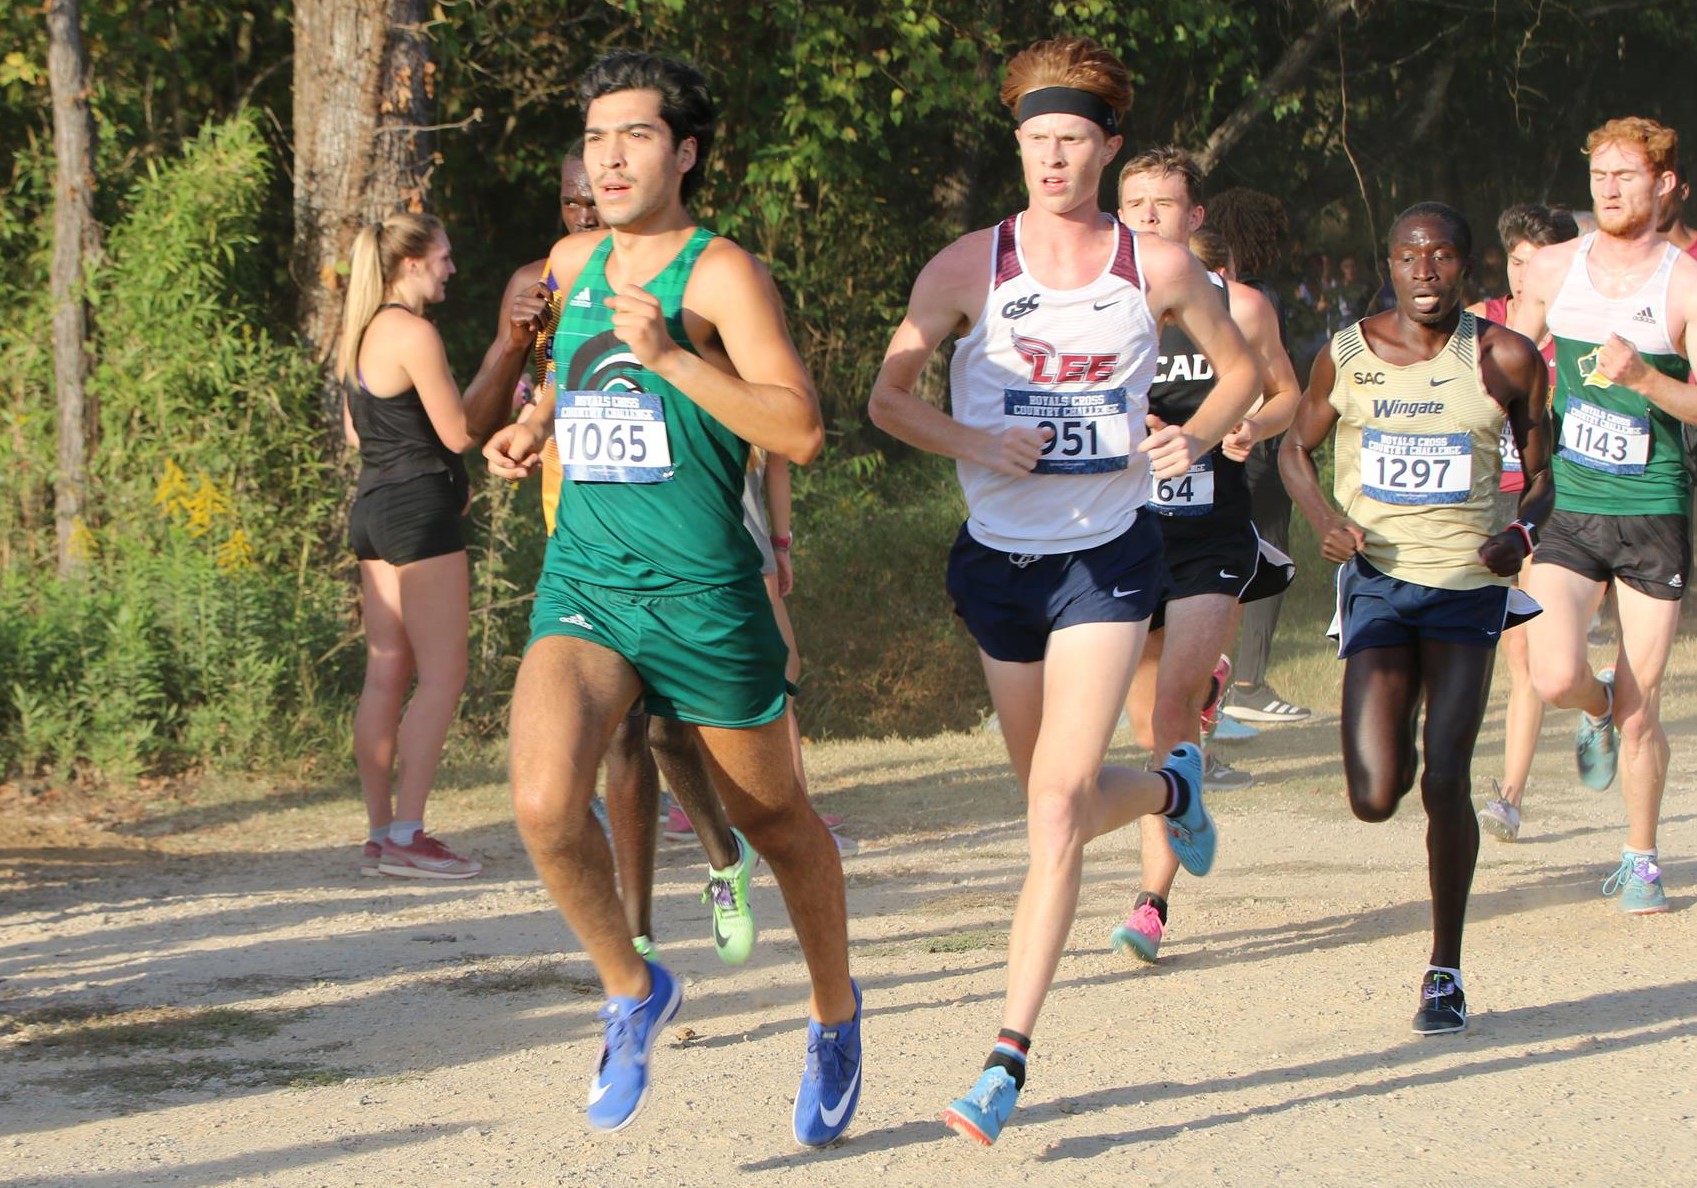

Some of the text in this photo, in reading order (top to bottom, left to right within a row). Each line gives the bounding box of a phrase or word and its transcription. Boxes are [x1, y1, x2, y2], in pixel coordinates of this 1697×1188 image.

[1029, 352, 1121, 385] LEE
[1353, 372, 1385, 385] SAC
[1028, 395, 1105, 406] ROYALS CROSS
[1372, 399, 1444, 418] Wingate
[1013, 404, 1119, 417] COUNTRY CHALLENGE
[566, 422, 647, 463] 1065
[1037, 420, 1098, 456] 951
[1380, 435, 1448, 447] ROYALS CROSS
[1575, 423, 1628, 461] 1143
[1368, 441, 1462, 455] COUNTRY CHALLENGE
[1376, 456, 1451, 489] 1297
